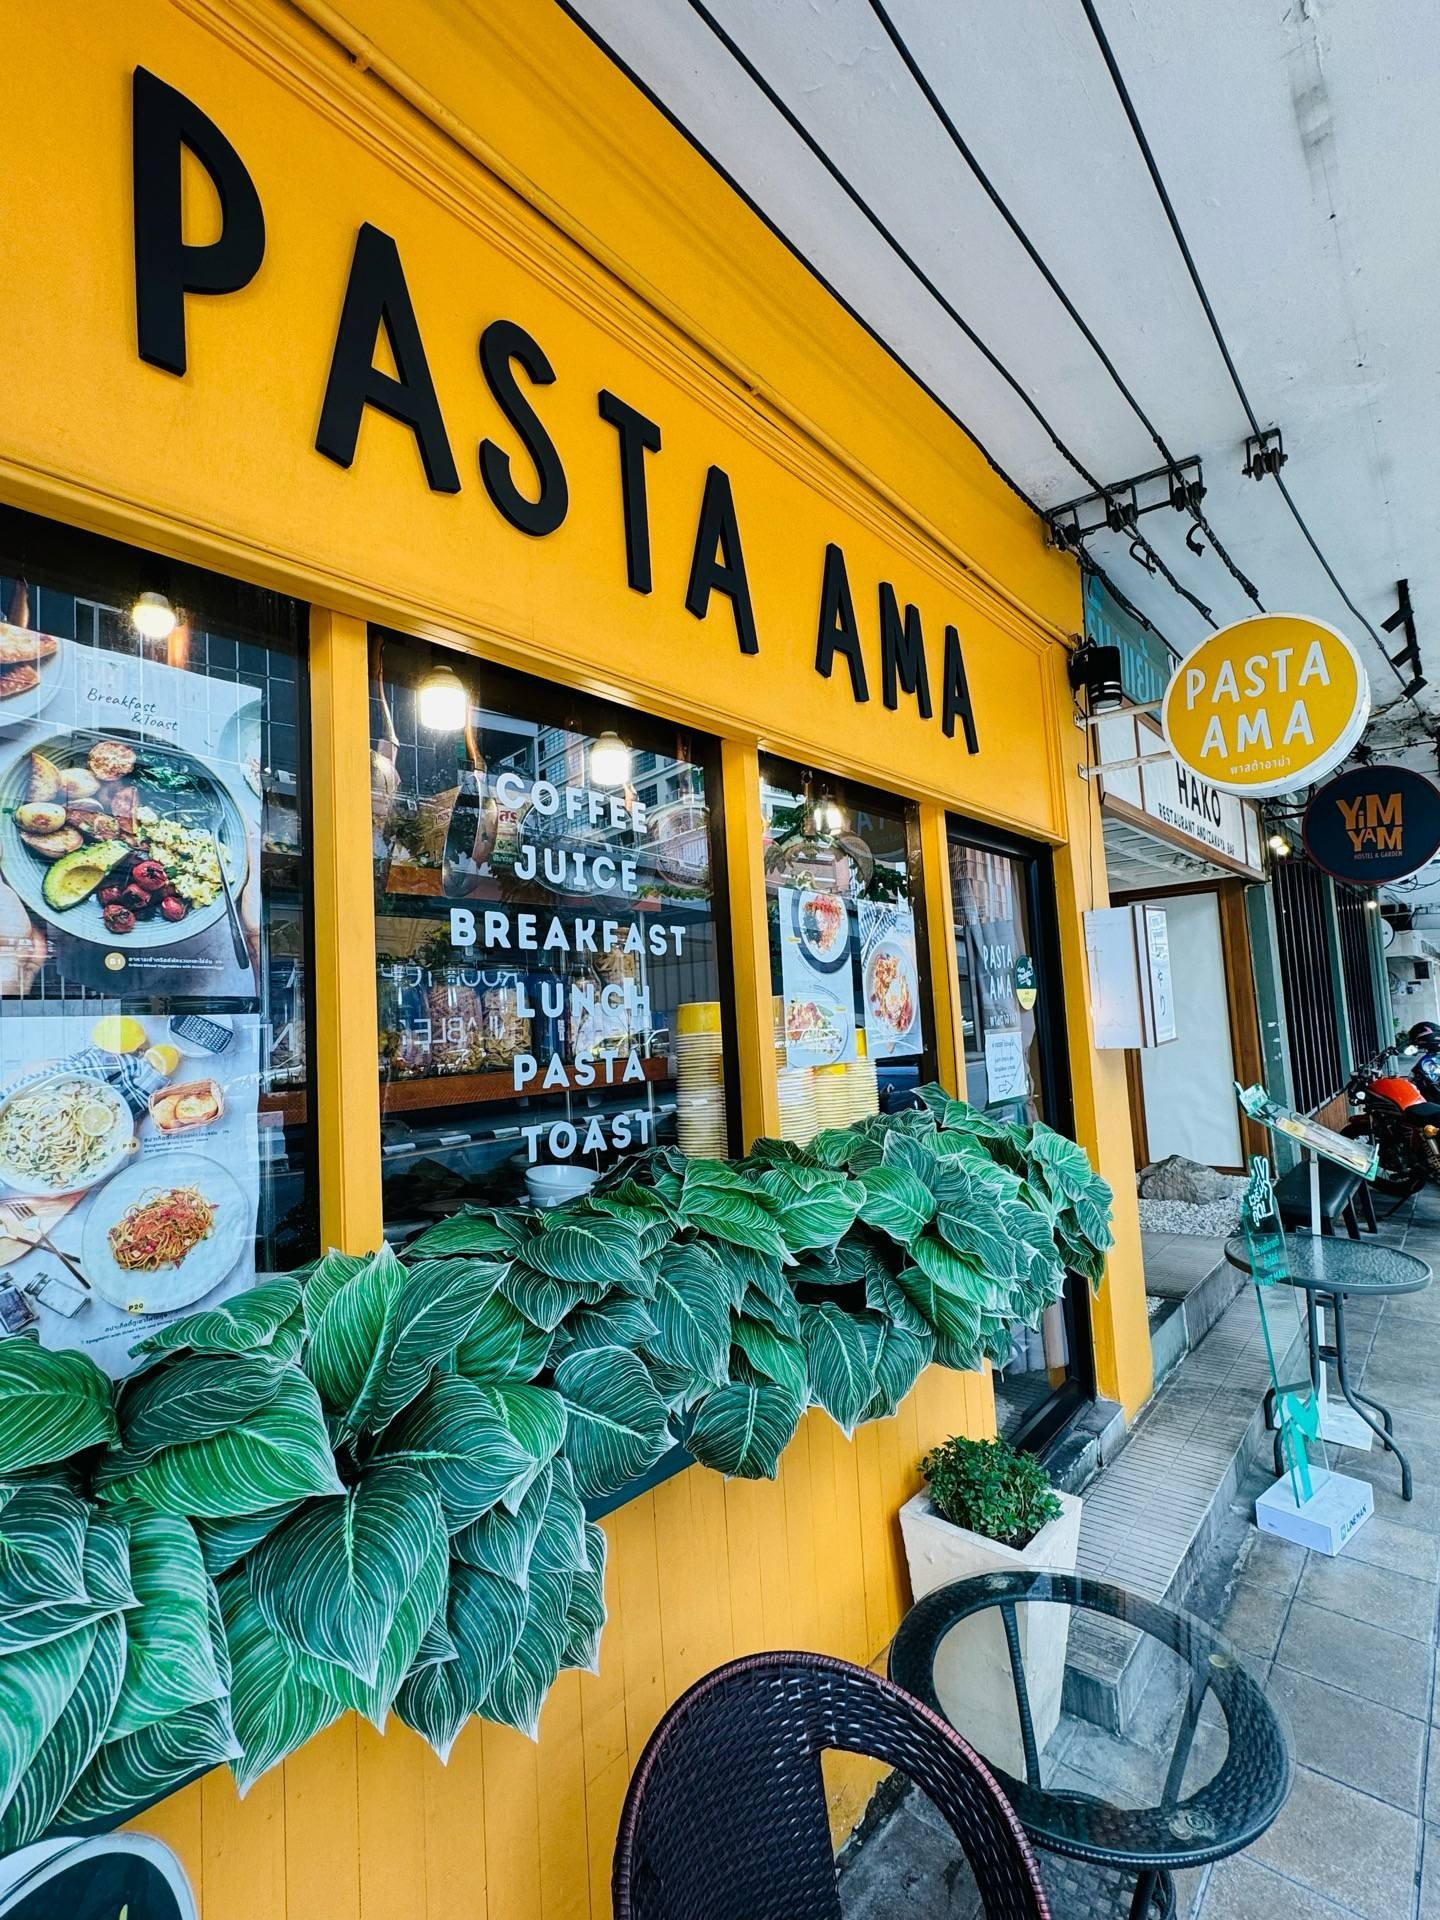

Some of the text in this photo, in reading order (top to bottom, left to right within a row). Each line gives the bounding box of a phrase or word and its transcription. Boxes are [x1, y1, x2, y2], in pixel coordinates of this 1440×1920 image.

[133, 66, 980, 755] PASTA AMA
[1186, 640, 1331, 710] PASTA
[87, 687, 157, 713] Breakfast
[1200, 700, 1315, 759] AMA
[496, 771, 648, 834] COFFEE
[1175, 760, 1221, 828] HAKO
[1158, 802, 1195, 835] RESTAURANT
[1347, 826, 1403, 852] YAM
[514, 844, 639, 893] JUICE
[1354, 852, 1374, 860] HOSTEL
[1380, 850, 1403, 858] GARDEN
[450, 907, 687, 957] BREAKFAST
[983, 944, 1013, 970] PASTA
[515, 981, 651, 1020] LUNCH
[990, 974, 1013, 1000] AMA
[513, 1049, 647, 1092] PASTA
[521, 1110, 654, 1163] TOAST
[128, 1302, 144, 1311] P20
